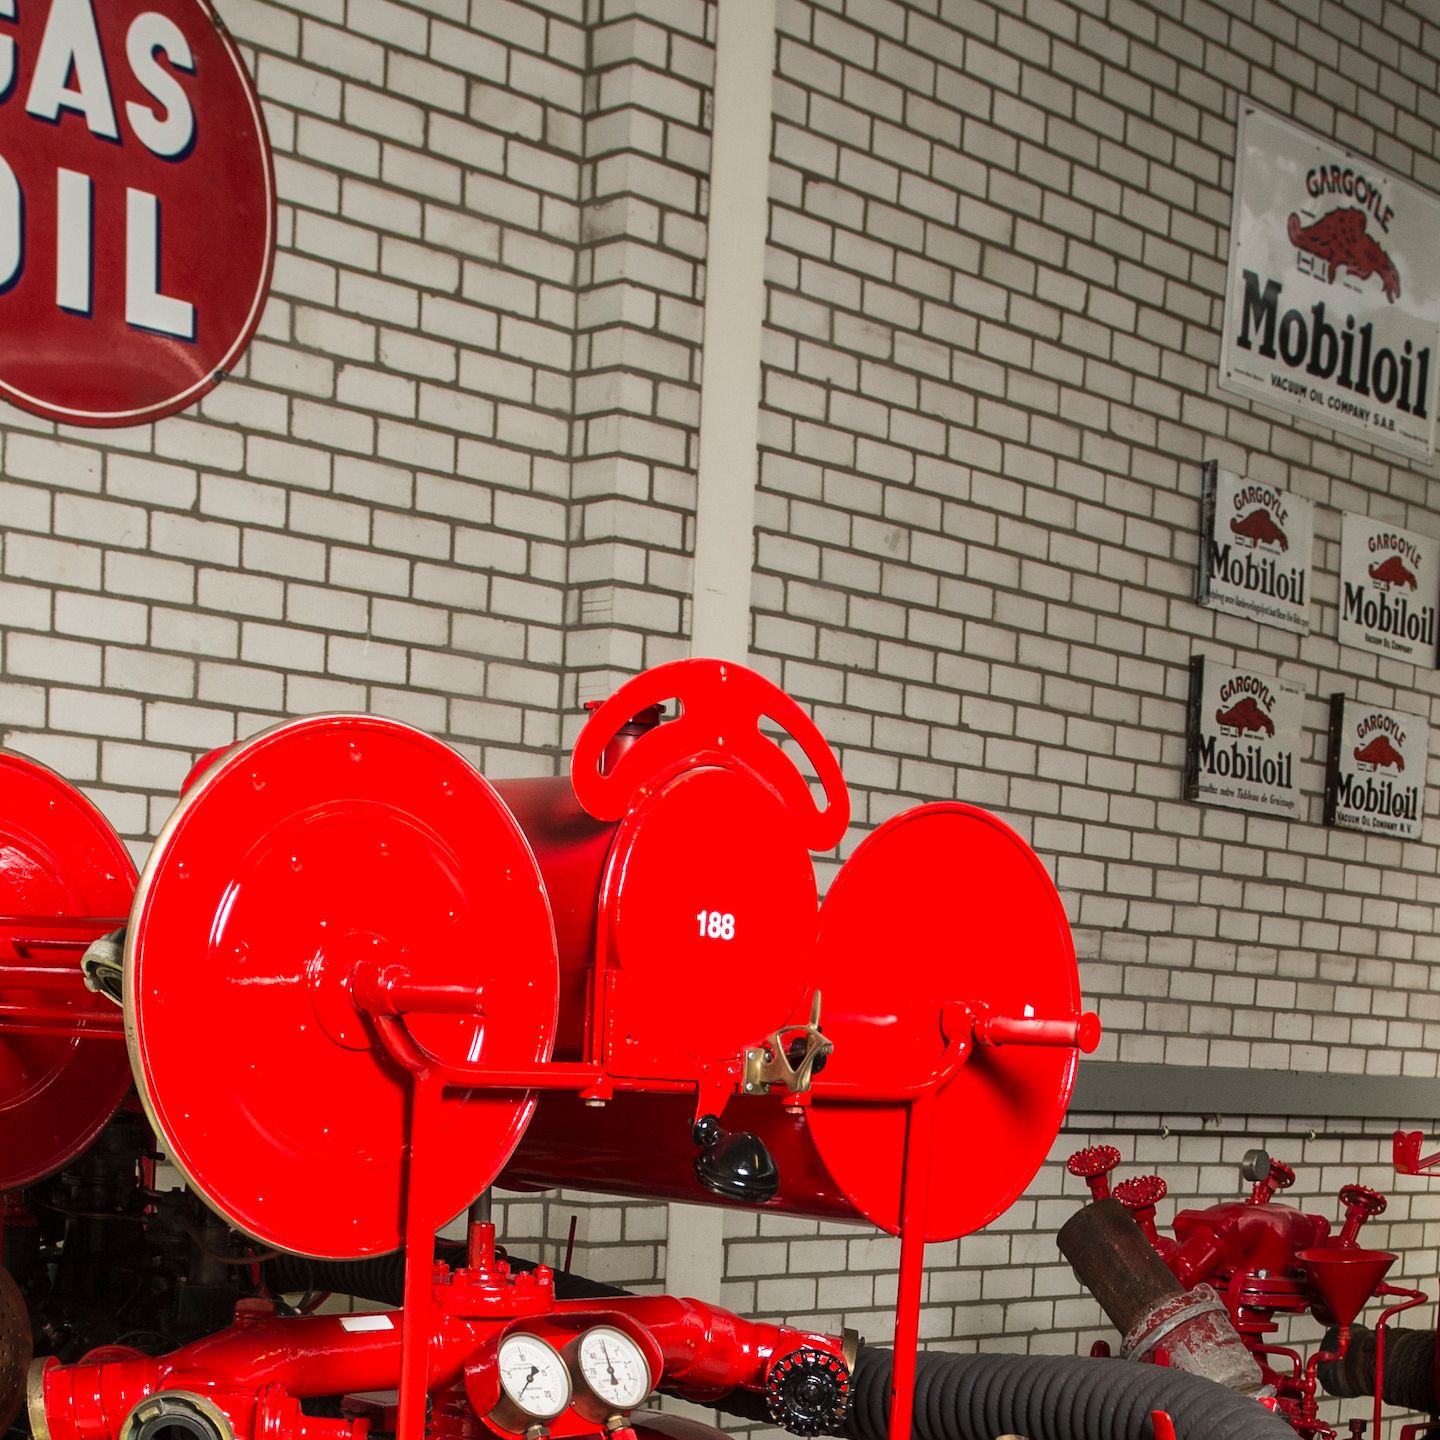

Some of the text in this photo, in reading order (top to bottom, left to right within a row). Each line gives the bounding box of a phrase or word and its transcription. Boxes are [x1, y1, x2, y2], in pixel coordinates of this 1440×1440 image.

[1306, 164, 1395, 234] GARGOYLE
[1236, 268, 1430, 420] Mobiloil
[1271, 373, 1307, 399] VACUUM
[1310, 388, 1324, 405] OIL
[1328, 396, 1371, 422] COMPANY
[1233, 486, 1289, 526] GARGOYLE
[1210, 540, 1305, 607] Mobiloil
[1368, 532, 1422, 570] GARGOYLE
[1342, 581, 1435, 647] Mobiloil
[1220, 675, 1276, 713] GARGOYLE
[1356, 714, 1407, 748] GARGOYLE
[1198, 733, 1293, 790] Mobiloil
[1336, 771, 1418, 821] Mobiloil
[696, 910, 735, 940] 188
